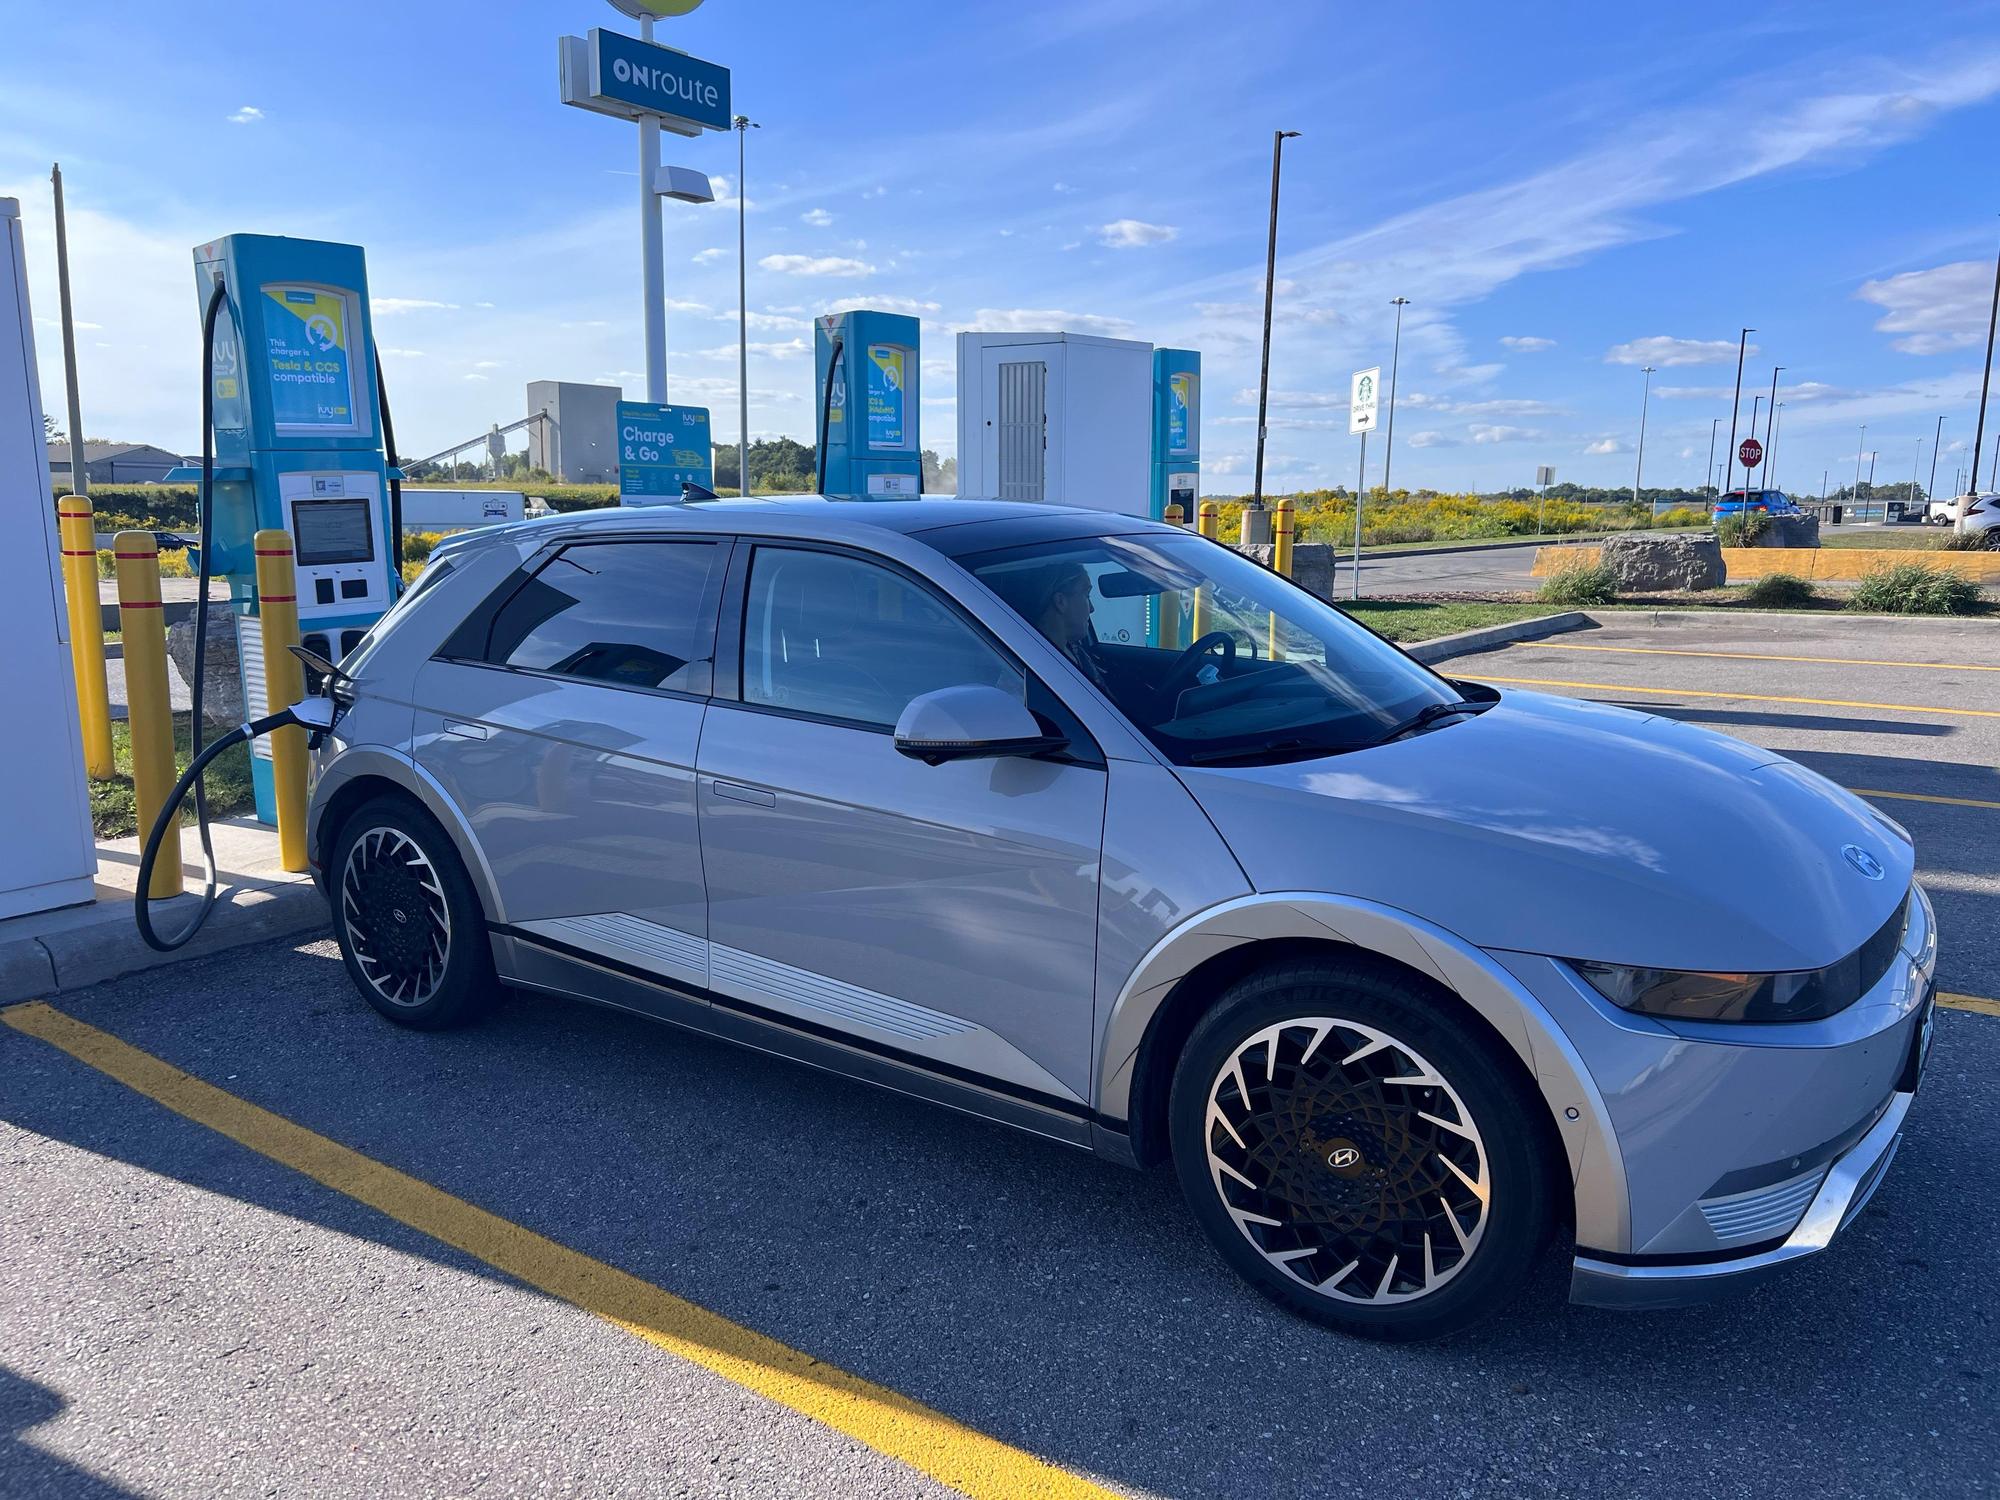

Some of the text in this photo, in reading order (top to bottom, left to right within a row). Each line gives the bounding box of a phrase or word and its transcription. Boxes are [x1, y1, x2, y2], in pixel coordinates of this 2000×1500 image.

[613, 58, 718, 107] ONroute
[269, 338, 286, 347] This
[270, 347, 302, 357] charger
[271, 359, 340, 373] Tesla & CCS
[273, 373, 336, 384] compatible
[318, 403, 334, 418] ivy
[623, 426, 674, 447] Charge
[624, 445, 659, 461] & Go
[1740, 447, 1761, 459] STOP
